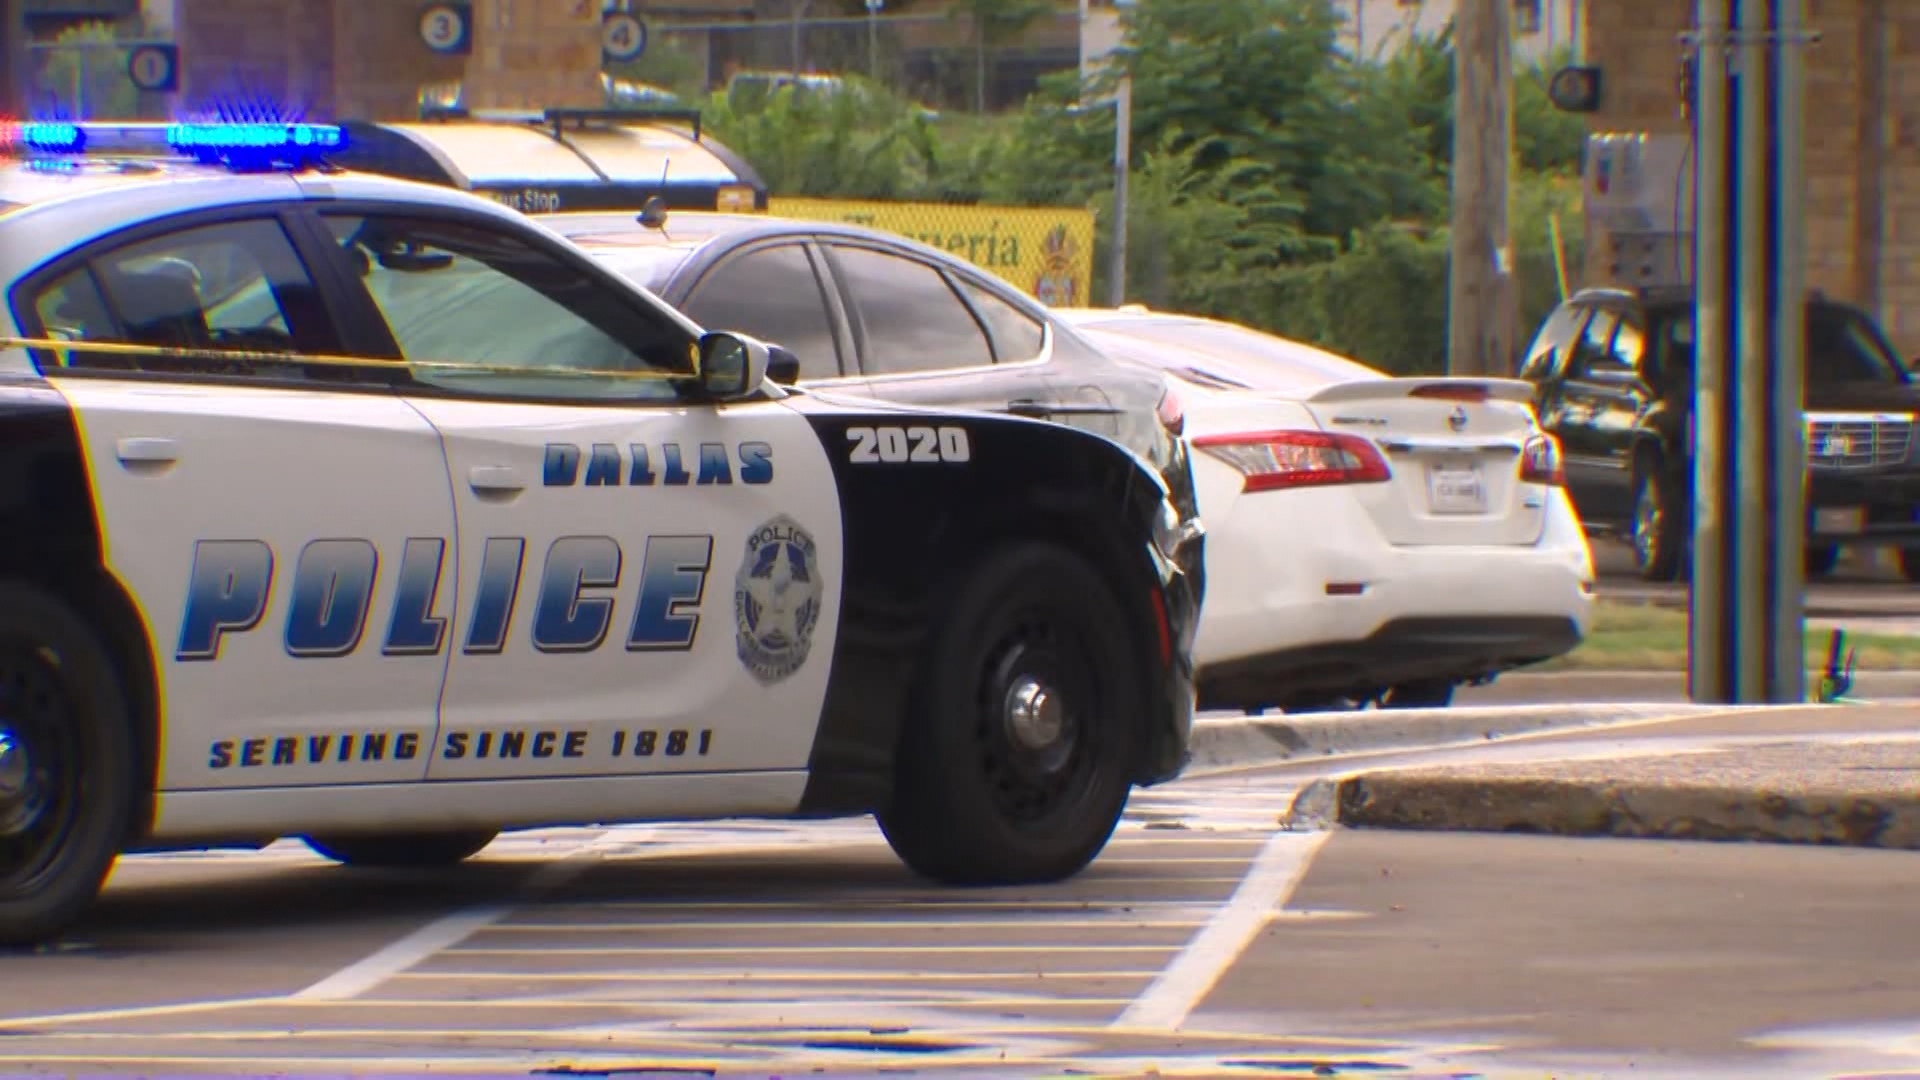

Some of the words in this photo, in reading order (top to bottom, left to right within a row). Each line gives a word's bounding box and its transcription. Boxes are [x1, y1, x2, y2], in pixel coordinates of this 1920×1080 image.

[432, 14, 450, 41] 3
[610, 22, 630, 48] 4
[523, 188, 560, 214] Stop
[846, 427, 970, 463] 2020
[543, 442, 774, 486] DALLAS
[748, 525, 815, 557] POLICE
[175, 535, 714, 661] POLICE
[208, 733, 420, 769] SERVING
[443, 730, 588, 759] SINCE
[611, 728, 713, 756] 1881
